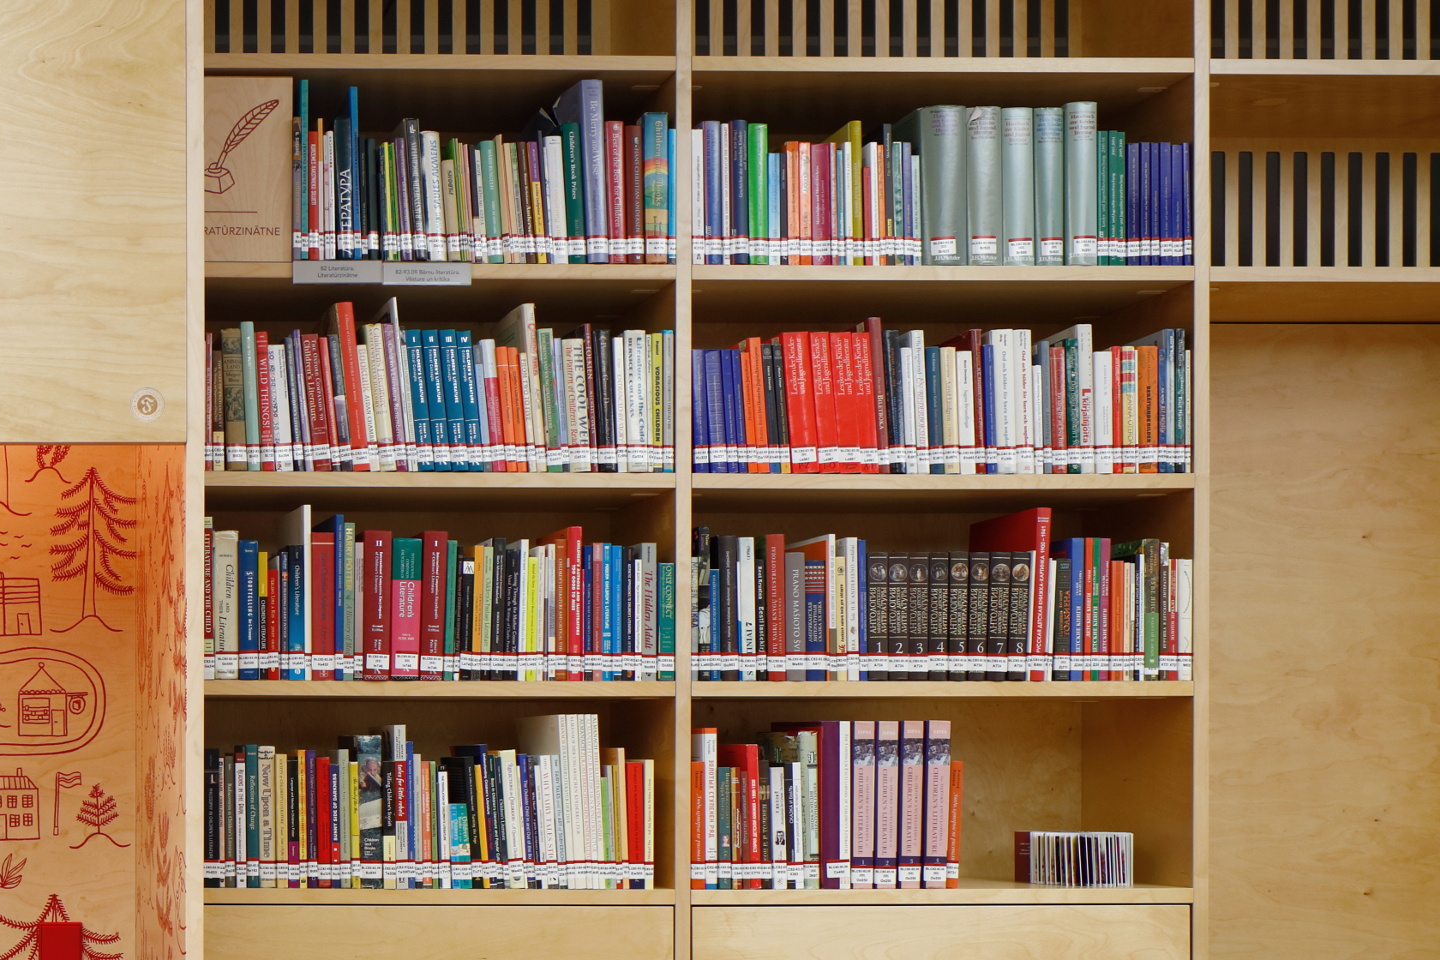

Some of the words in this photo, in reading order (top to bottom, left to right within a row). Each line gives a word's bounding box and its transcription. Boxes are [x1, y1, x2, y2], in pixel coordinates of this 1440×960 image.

[259, 358, 268, 384] WILD
[345, 528, 353, 556] HARRY
[876, 642, 882, 653] 1
[895, 642, 903, 653] 2
[916, 642, 922, 654] 3
[935, 642, 944, 653] 4
[957, 642, 963, 653] 5
[976, 642, 983, 653] 6
[996, 642, 1003, 653] 7
[1015, 642, 1023, 653] 8
